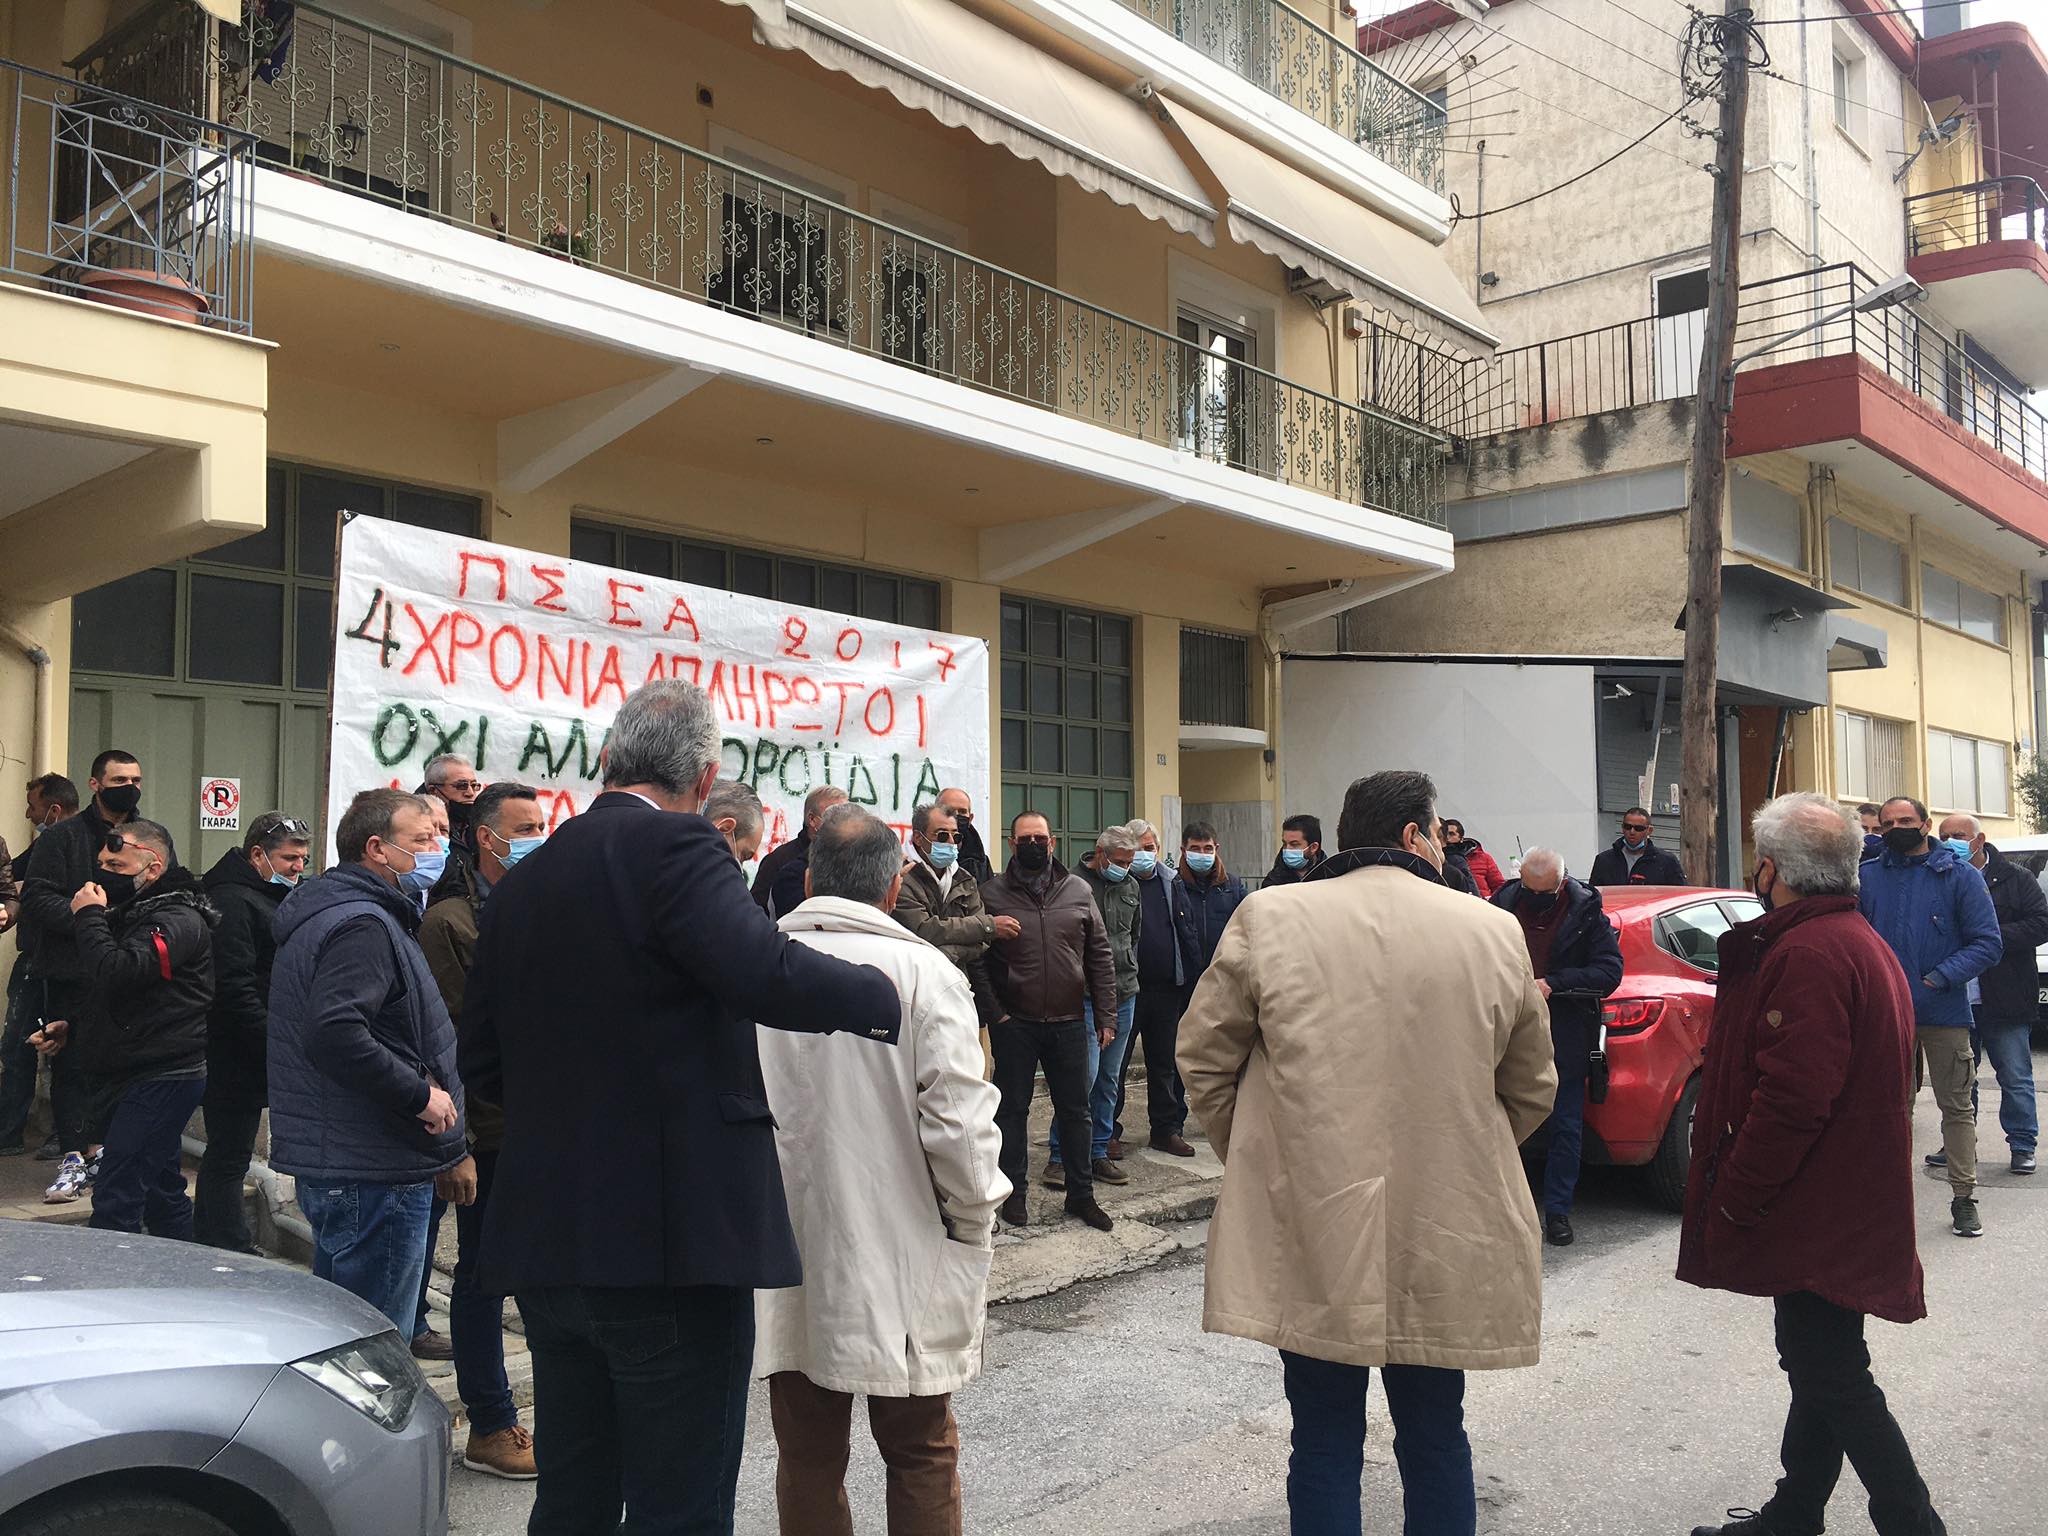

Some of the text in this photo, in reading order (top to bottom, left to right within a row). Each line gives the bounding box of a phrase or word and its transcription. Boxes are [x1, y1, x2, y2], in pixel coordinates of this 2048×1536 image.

[458, 551, 957, 682] ΠΣΕΑ 2017
[373, 703, 489, 771] ΟΧΙ
[202, 817, 237, 829] ΓΚΑΡΑΖ
